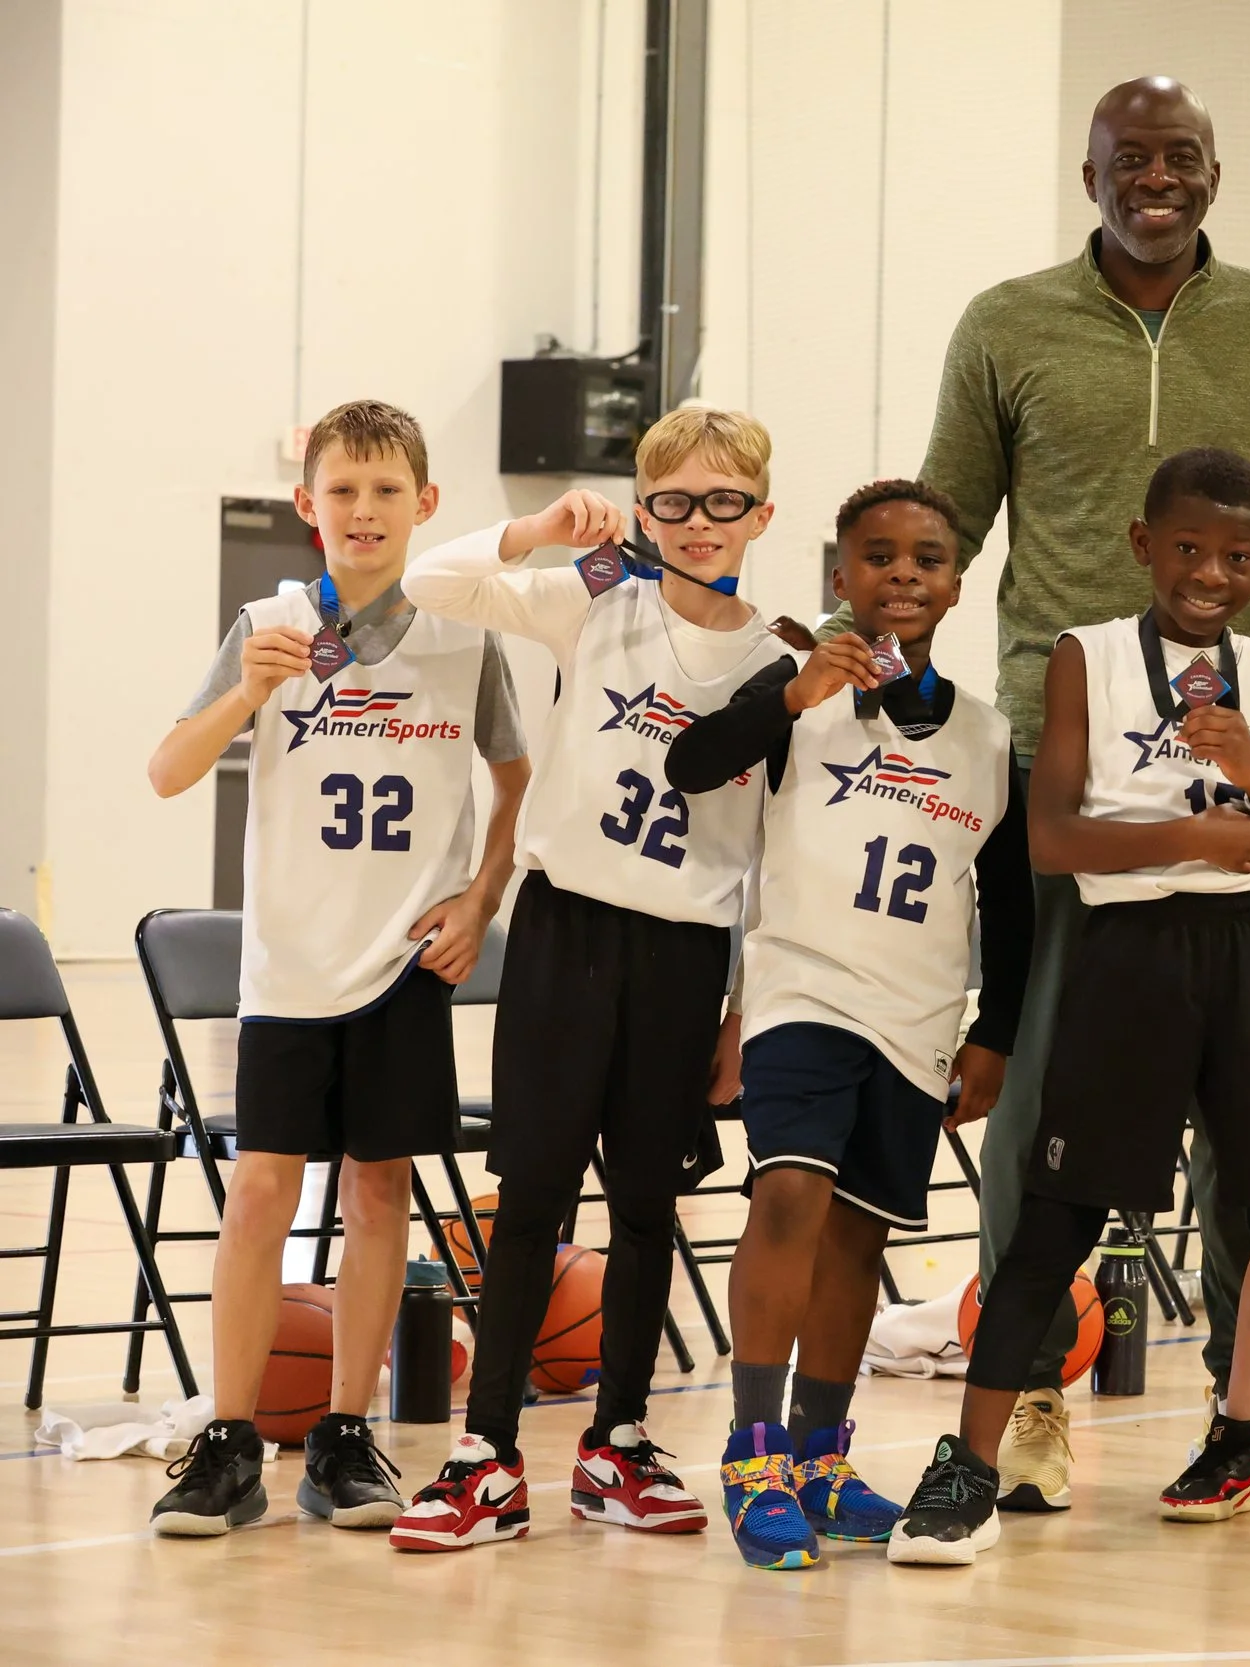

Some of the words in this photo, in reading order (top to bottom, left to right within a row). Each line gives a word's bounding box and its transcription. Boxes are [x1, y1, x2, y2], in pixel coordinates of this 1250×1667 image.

[311, 717, 461, 744] AmeriSports
[321, 773, 413, 852] 32
[600, 768, 689, 869] 32
[854, 774, 983, 832] AmeriSports
[853, 835, 937, 924] 12
